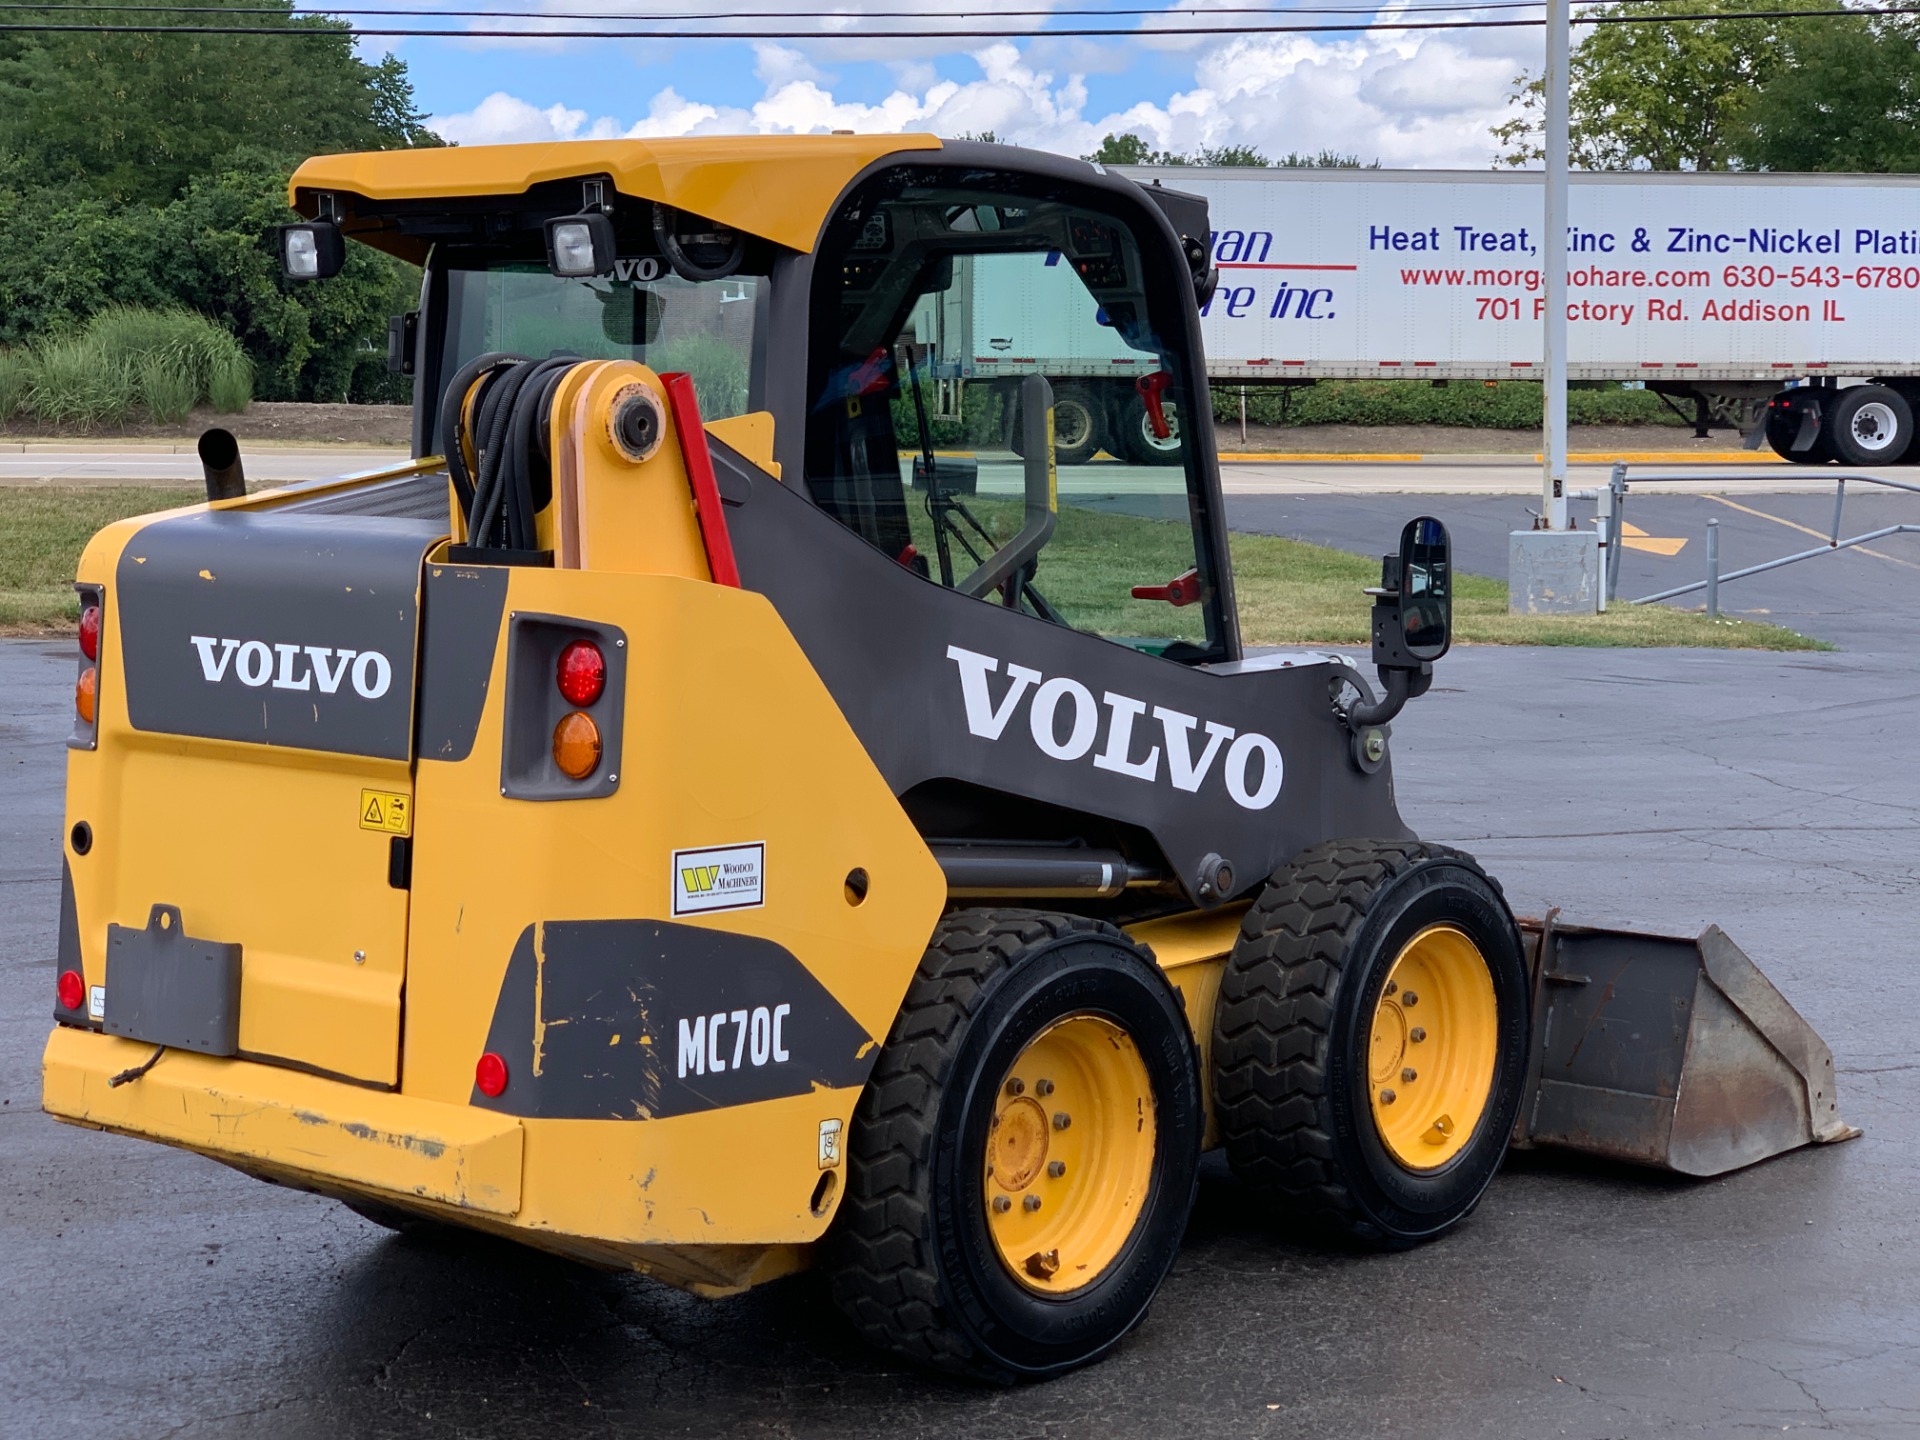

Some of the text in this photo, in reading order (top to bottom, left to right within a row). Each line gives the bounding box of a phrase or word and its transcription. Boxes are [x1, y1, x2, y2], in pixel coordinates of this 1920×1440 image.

[1369, 225, 1920, 256] Heat Treat, inc & Zinc-Nickel Plati
[1400, 265, 1920, 291] www.morgohare.com 630-543-6780
[1269, 282, 1336, 319] inc.
[1476, 298, 1846, 326] 701 Fctory Rd. Addison IL
[190, 635, 392, 699] VOLVO
[946, 644, 1284, 810] VOLVO
[678, 1003, 791, 1078] MC70C
